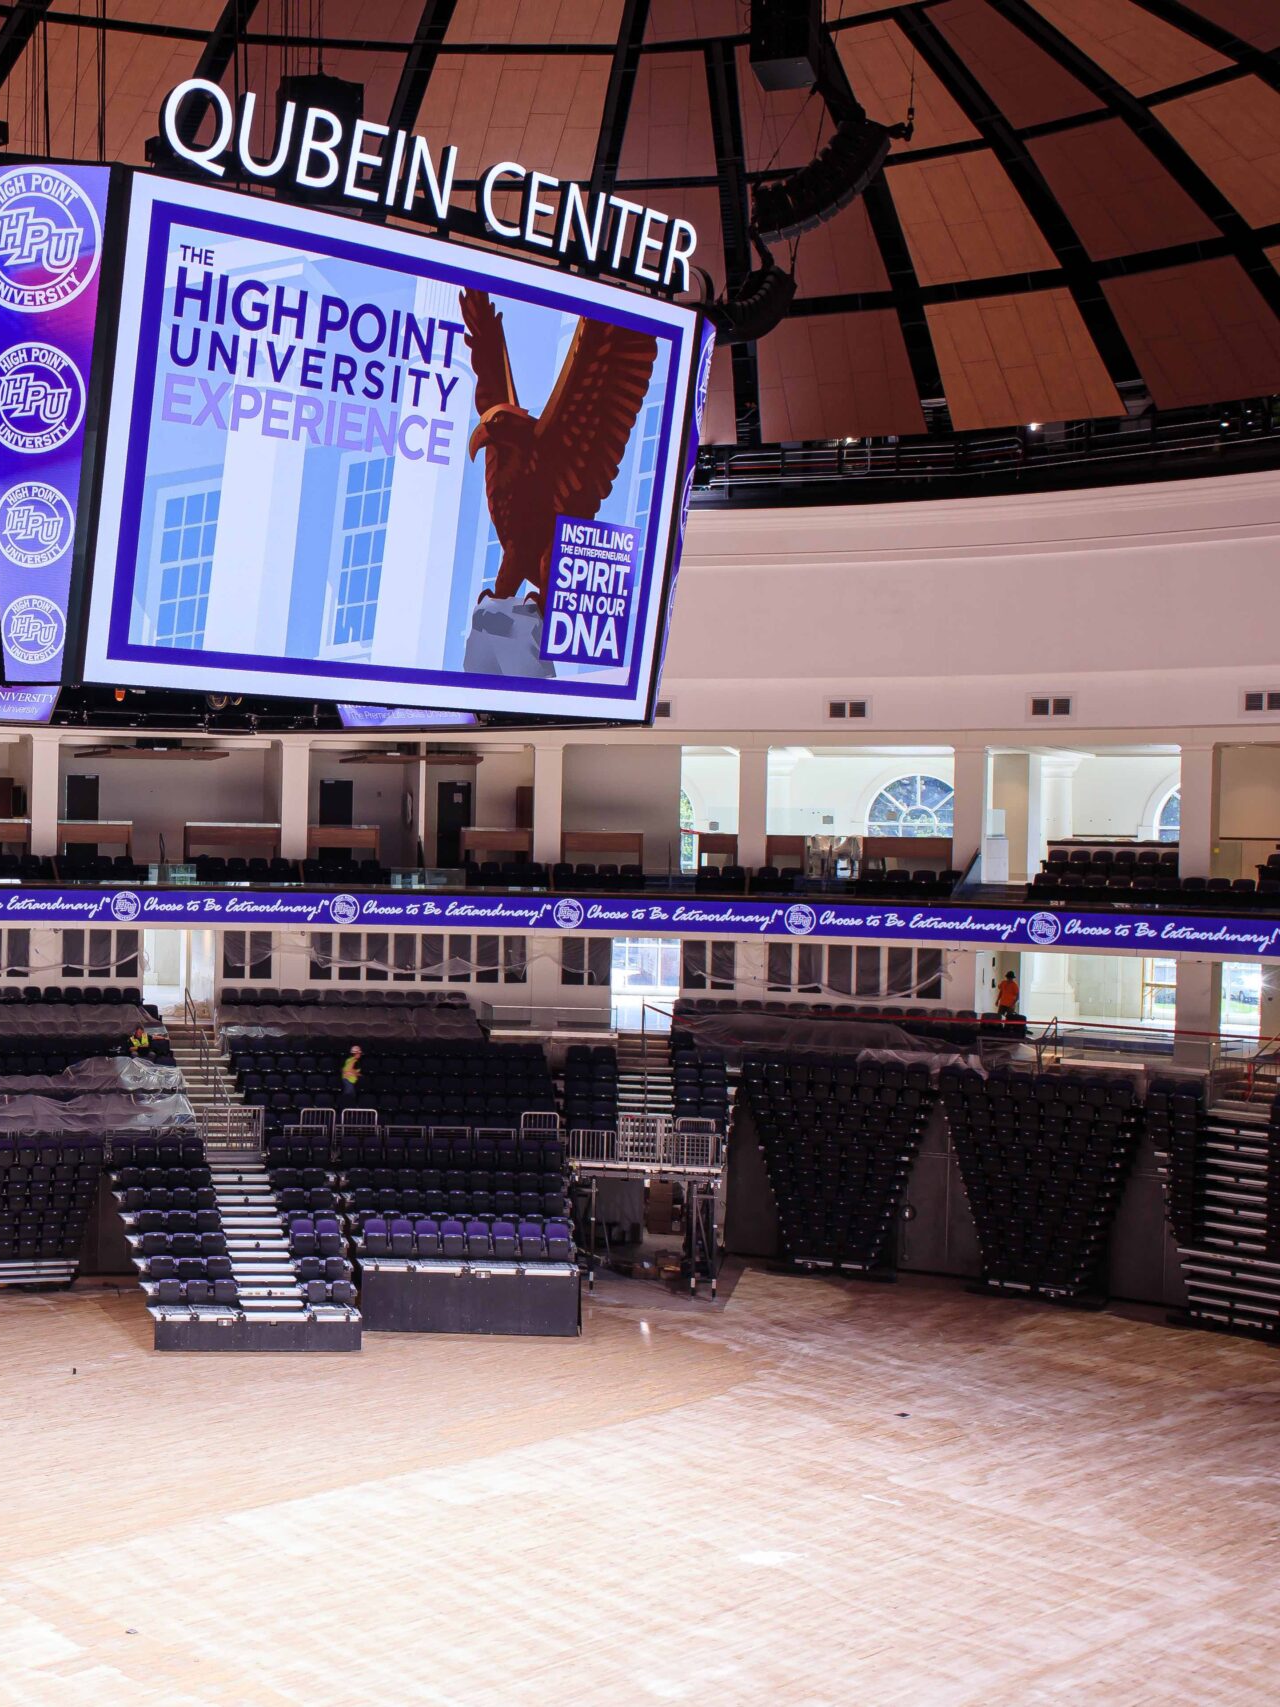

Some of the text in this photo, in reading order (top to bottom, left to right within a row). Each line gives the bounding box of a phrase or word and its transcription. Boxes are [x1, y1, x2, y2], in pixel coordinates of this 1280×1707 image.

[31, 174, 79, 206] POINT
[164, 78, 698, 292] QUBEIN CENTER
[179, 244, 215, 267] THE
[173, 266, 466, 369] HIGH POINT
[0, 348, 69, 373] HIGH POINT
[170, 324, 460, 412] UNIVERSITY
[161, 372, 455, 466] EXPERIENCE
[6, 486, 61, 505] HIGH POINT
[2, 505, 63, 545] HPU
[561, 523, 634, 552] INSTILLING
[5, 543, 62, 564] UNIVERSITY
[560, 544, 632, 563] THE ENTREPRENEURIAL
[556, 556, 631, 597] SPIRIT.
[553, 590, 626, 617] IT'S IN OUR
[8, 614, 58, 646] HPU
[546, 610, 619, 660] DNA
[143, 896, 185, 912] Choose
[186, 900, 201, 912] to
[362, 899, 404, 915] Choose
[405, 903, 421, 915] to
[422, 901, 443, 915] Be
[586, 904, 629, 920] Choose
[631, 908, 647, 920] to
[648, 906, 669, 920] Be
[819, 910, 864, 926] Choose
[865, 914, 882, 927] to
[884, 913, 906, 927] Be
[1064, 918, 1112, 936] Choose
[1114, 923, 1132, 937] to
[1134, 922, 1158, 938] Be
